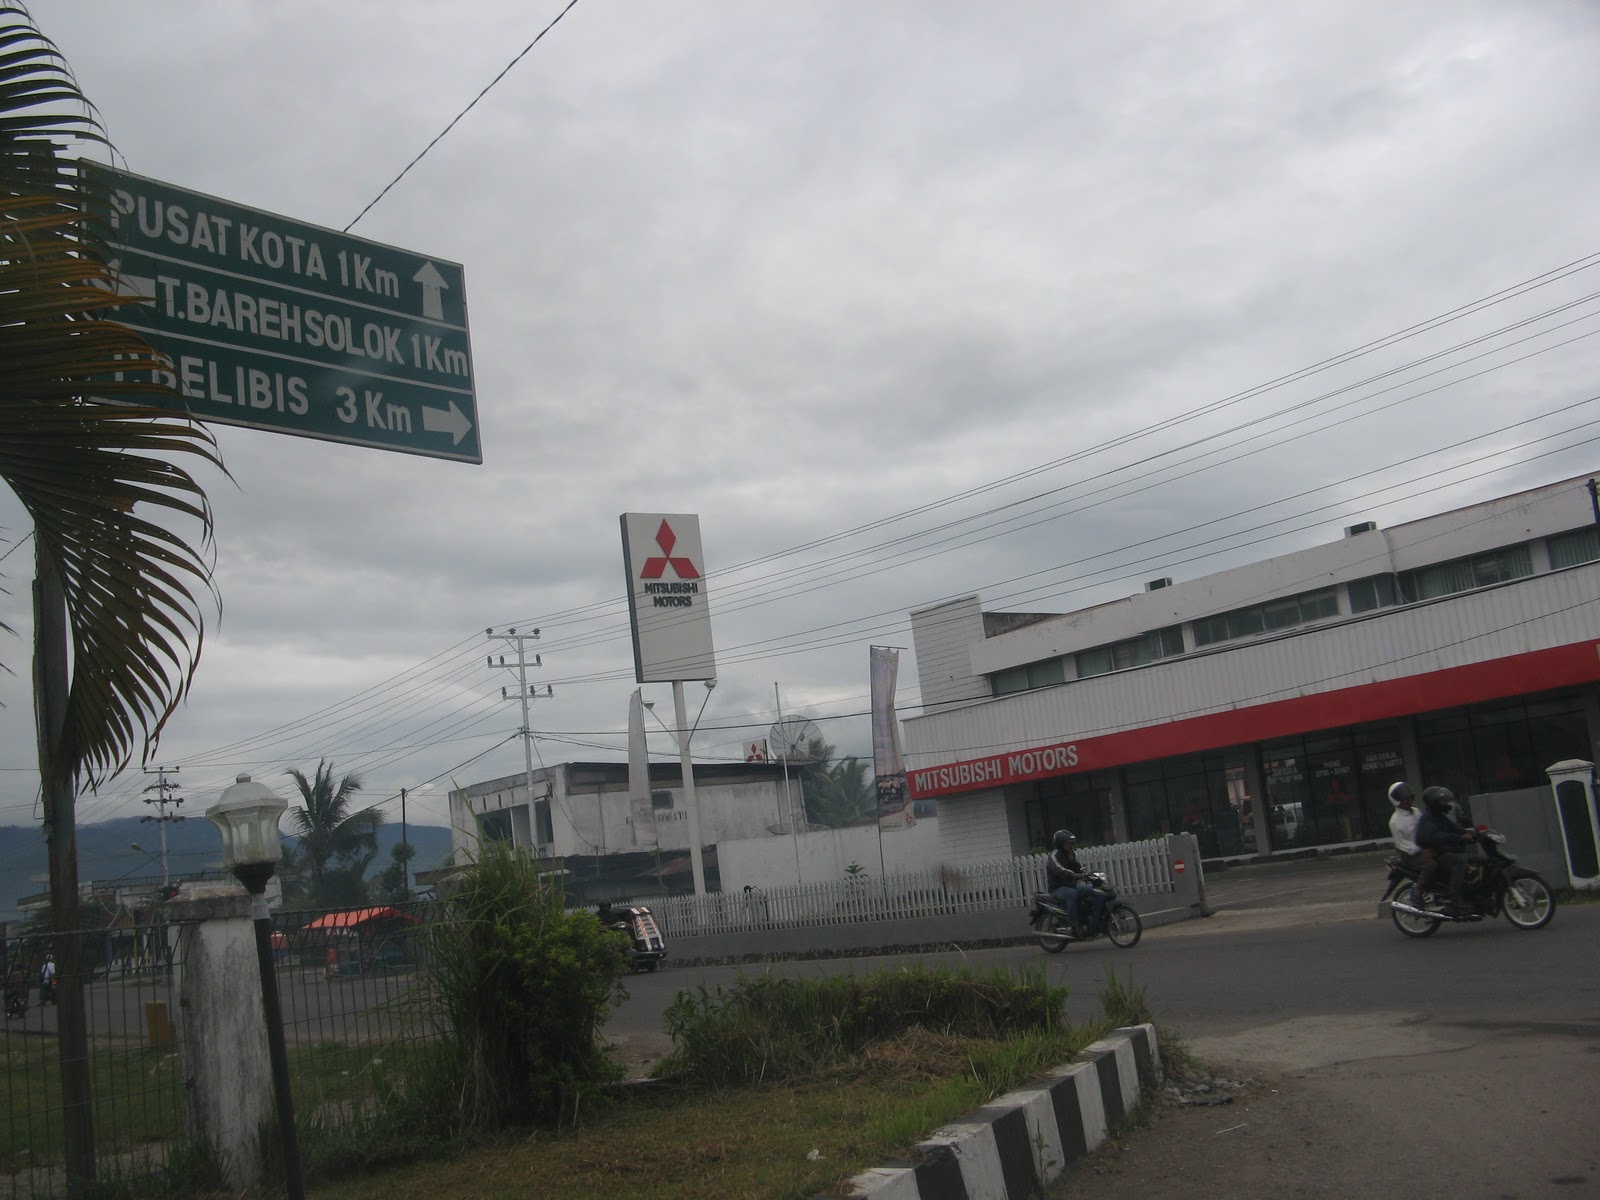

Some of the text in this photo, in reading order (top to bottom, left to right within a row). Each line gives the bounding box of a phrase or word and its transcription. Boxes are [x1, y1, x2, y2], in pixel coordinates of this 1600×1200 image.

[109, 188, 232, 256] PUSAT
[239, 222, 328, 282] KOTA
[644, 581, 699, 594] MITSUBISHI
[653, 595, 693, 608] MOTORS
[914, 745, 1079, 793] MITSUBISHI MOTORS
